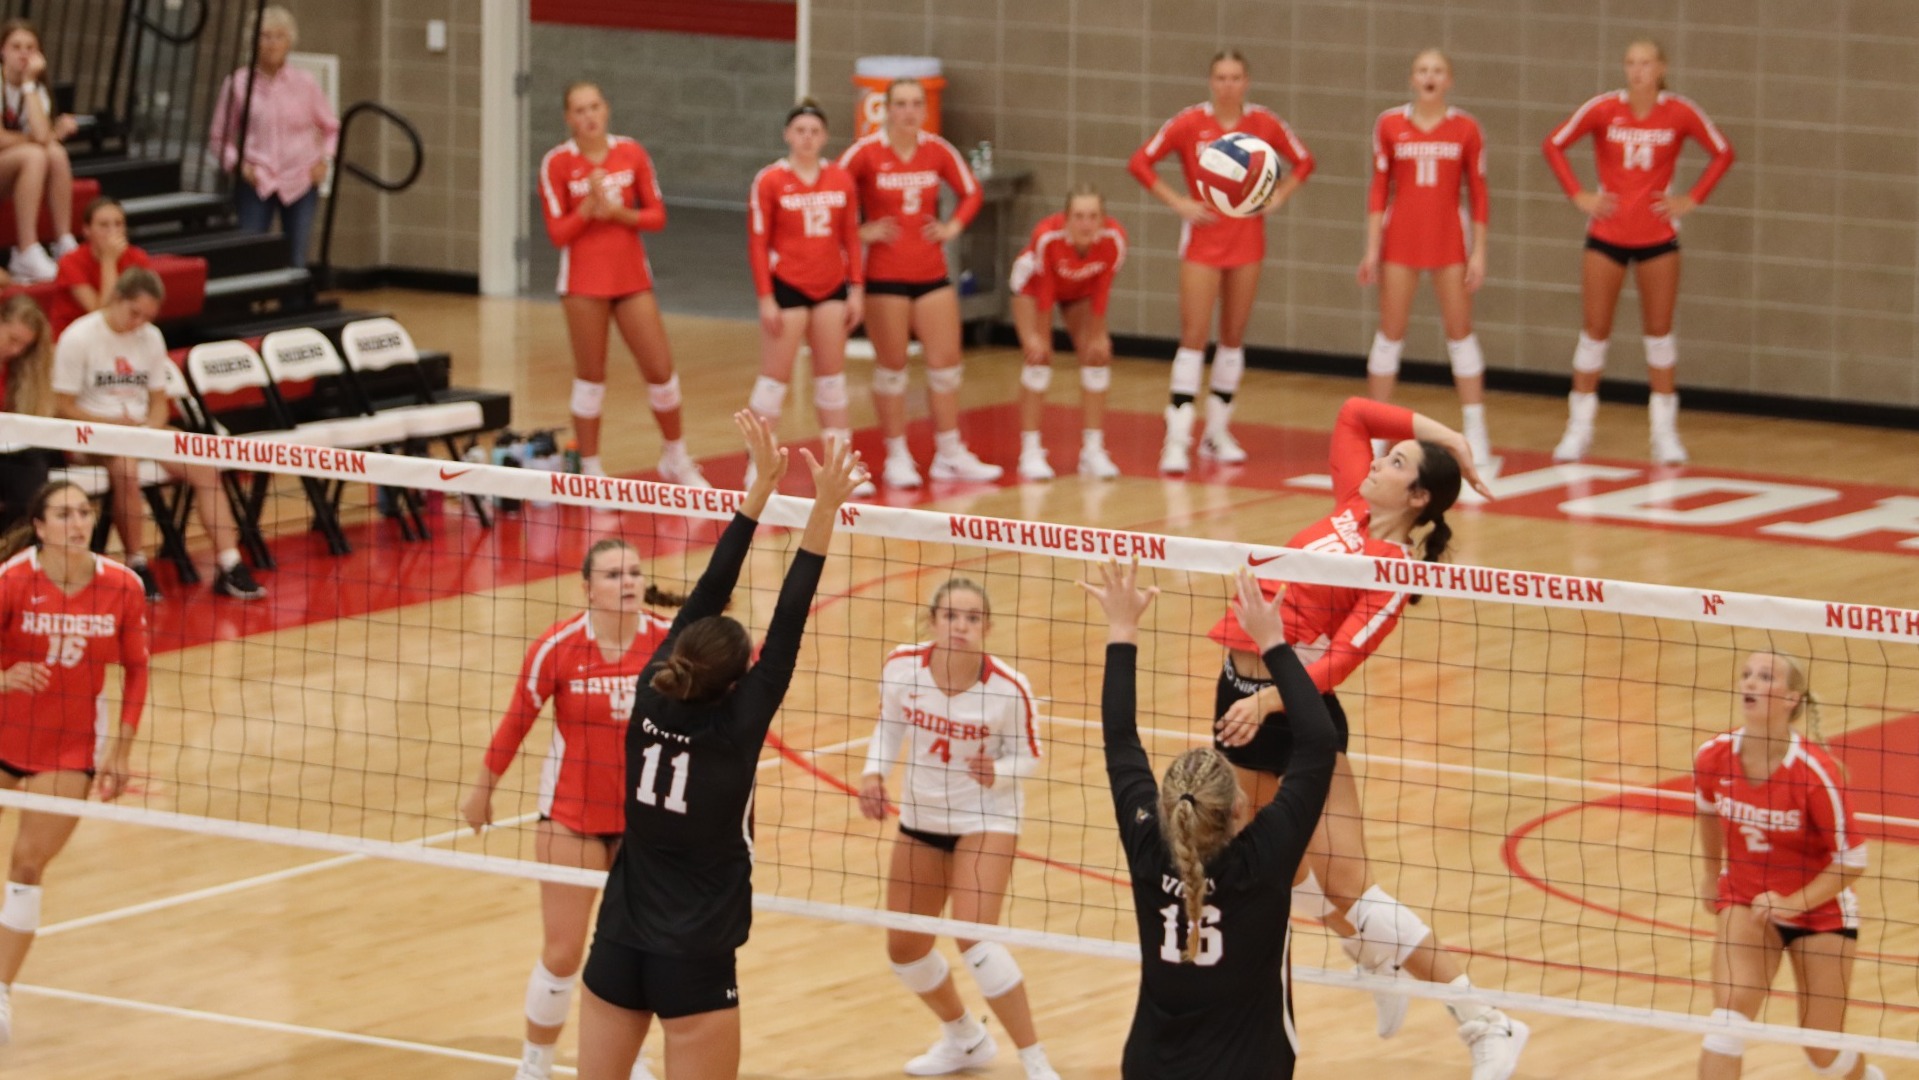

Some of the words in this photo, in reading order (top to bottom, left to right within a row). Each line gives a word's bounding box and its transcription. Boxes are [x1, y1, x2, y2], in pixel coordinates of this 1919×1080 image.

[1416, 158, 1438, 187] 11
[1624, 142, 1655, 171] 14
[803, 207, 832, 237] 12
[173, 432, 367, 474] NORTHWESTERN
[949, 515, 1167, 560] NORTHWESTERN
[1374, 559, 1604, 603] NORTHWESTERN
[22, 610, 116, 638] RAIDERS
[1825, 603, 1919, 636] NORTH
[46, 635, 87, 669] 16
[928, 738, 951, 763] 4
[636, 742, 690, 814] 11
[1739, 825, 1772, 852] 2
[1159, 904, 1223, 966] 16
